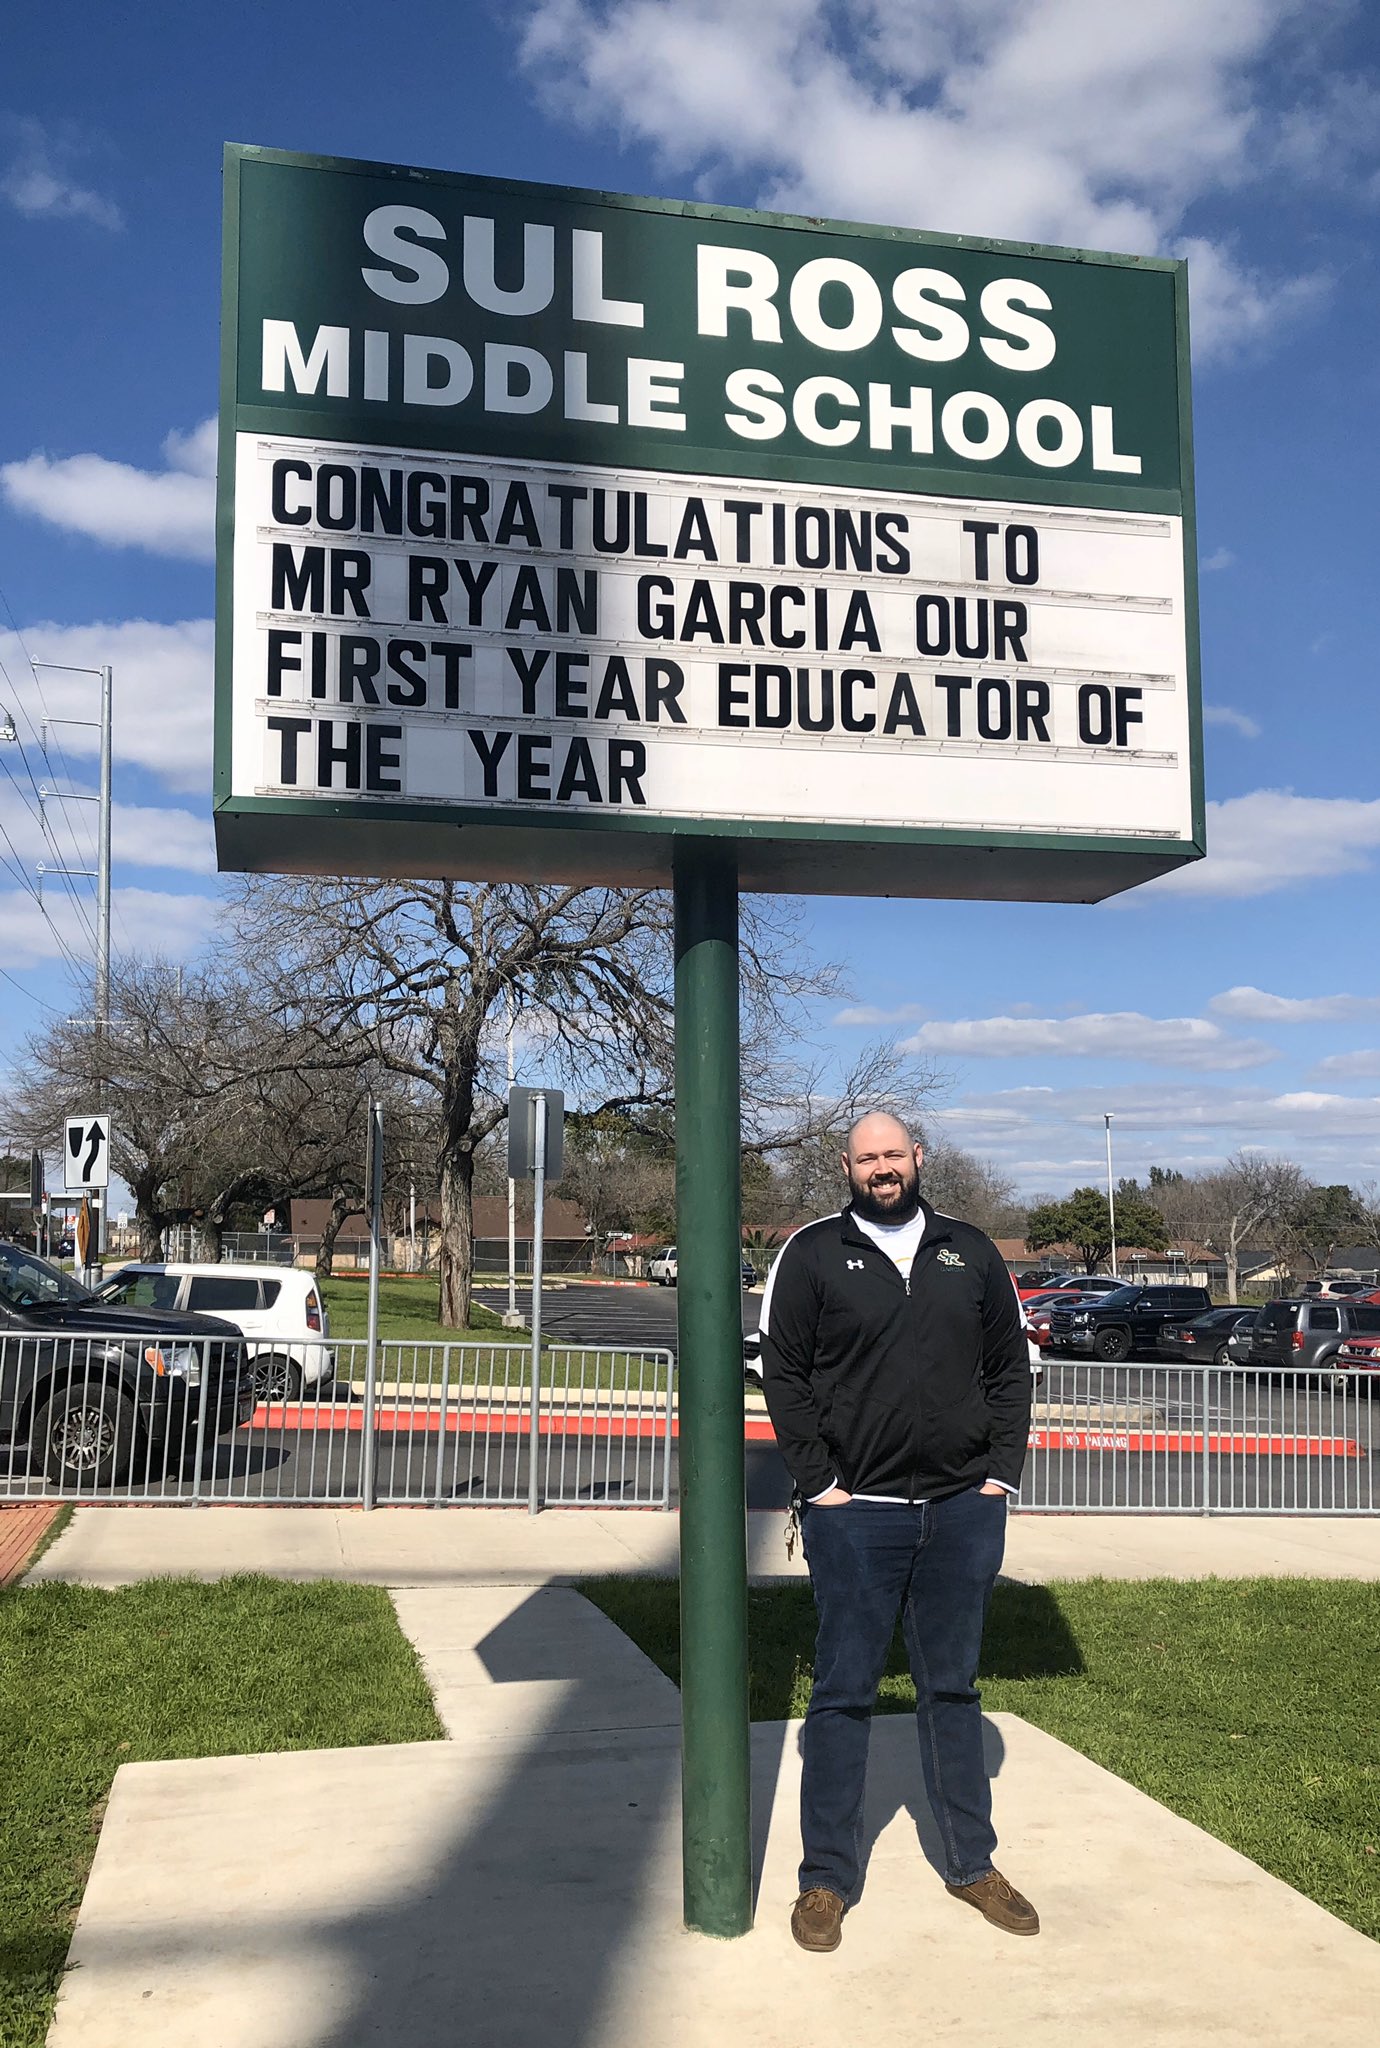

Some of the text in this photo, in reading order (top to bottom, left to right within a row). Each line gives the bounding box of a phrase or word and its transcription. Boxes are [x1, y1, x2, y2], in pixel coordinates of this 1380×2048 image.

[361, 204, 1057, 372] SUL ROSS
[262, 318, 1142, 475] MIDDLE SCHOOL
[272, 458, 1040, 586] CONGRATULATIONS TO
[271, 543, 1029, 662] MR RYAN GARCIA OUR
[267, 629, 1143, 746] FIRST YEAR EDUCATOR OF
[267, 717, 646, 805] THE YEAR
